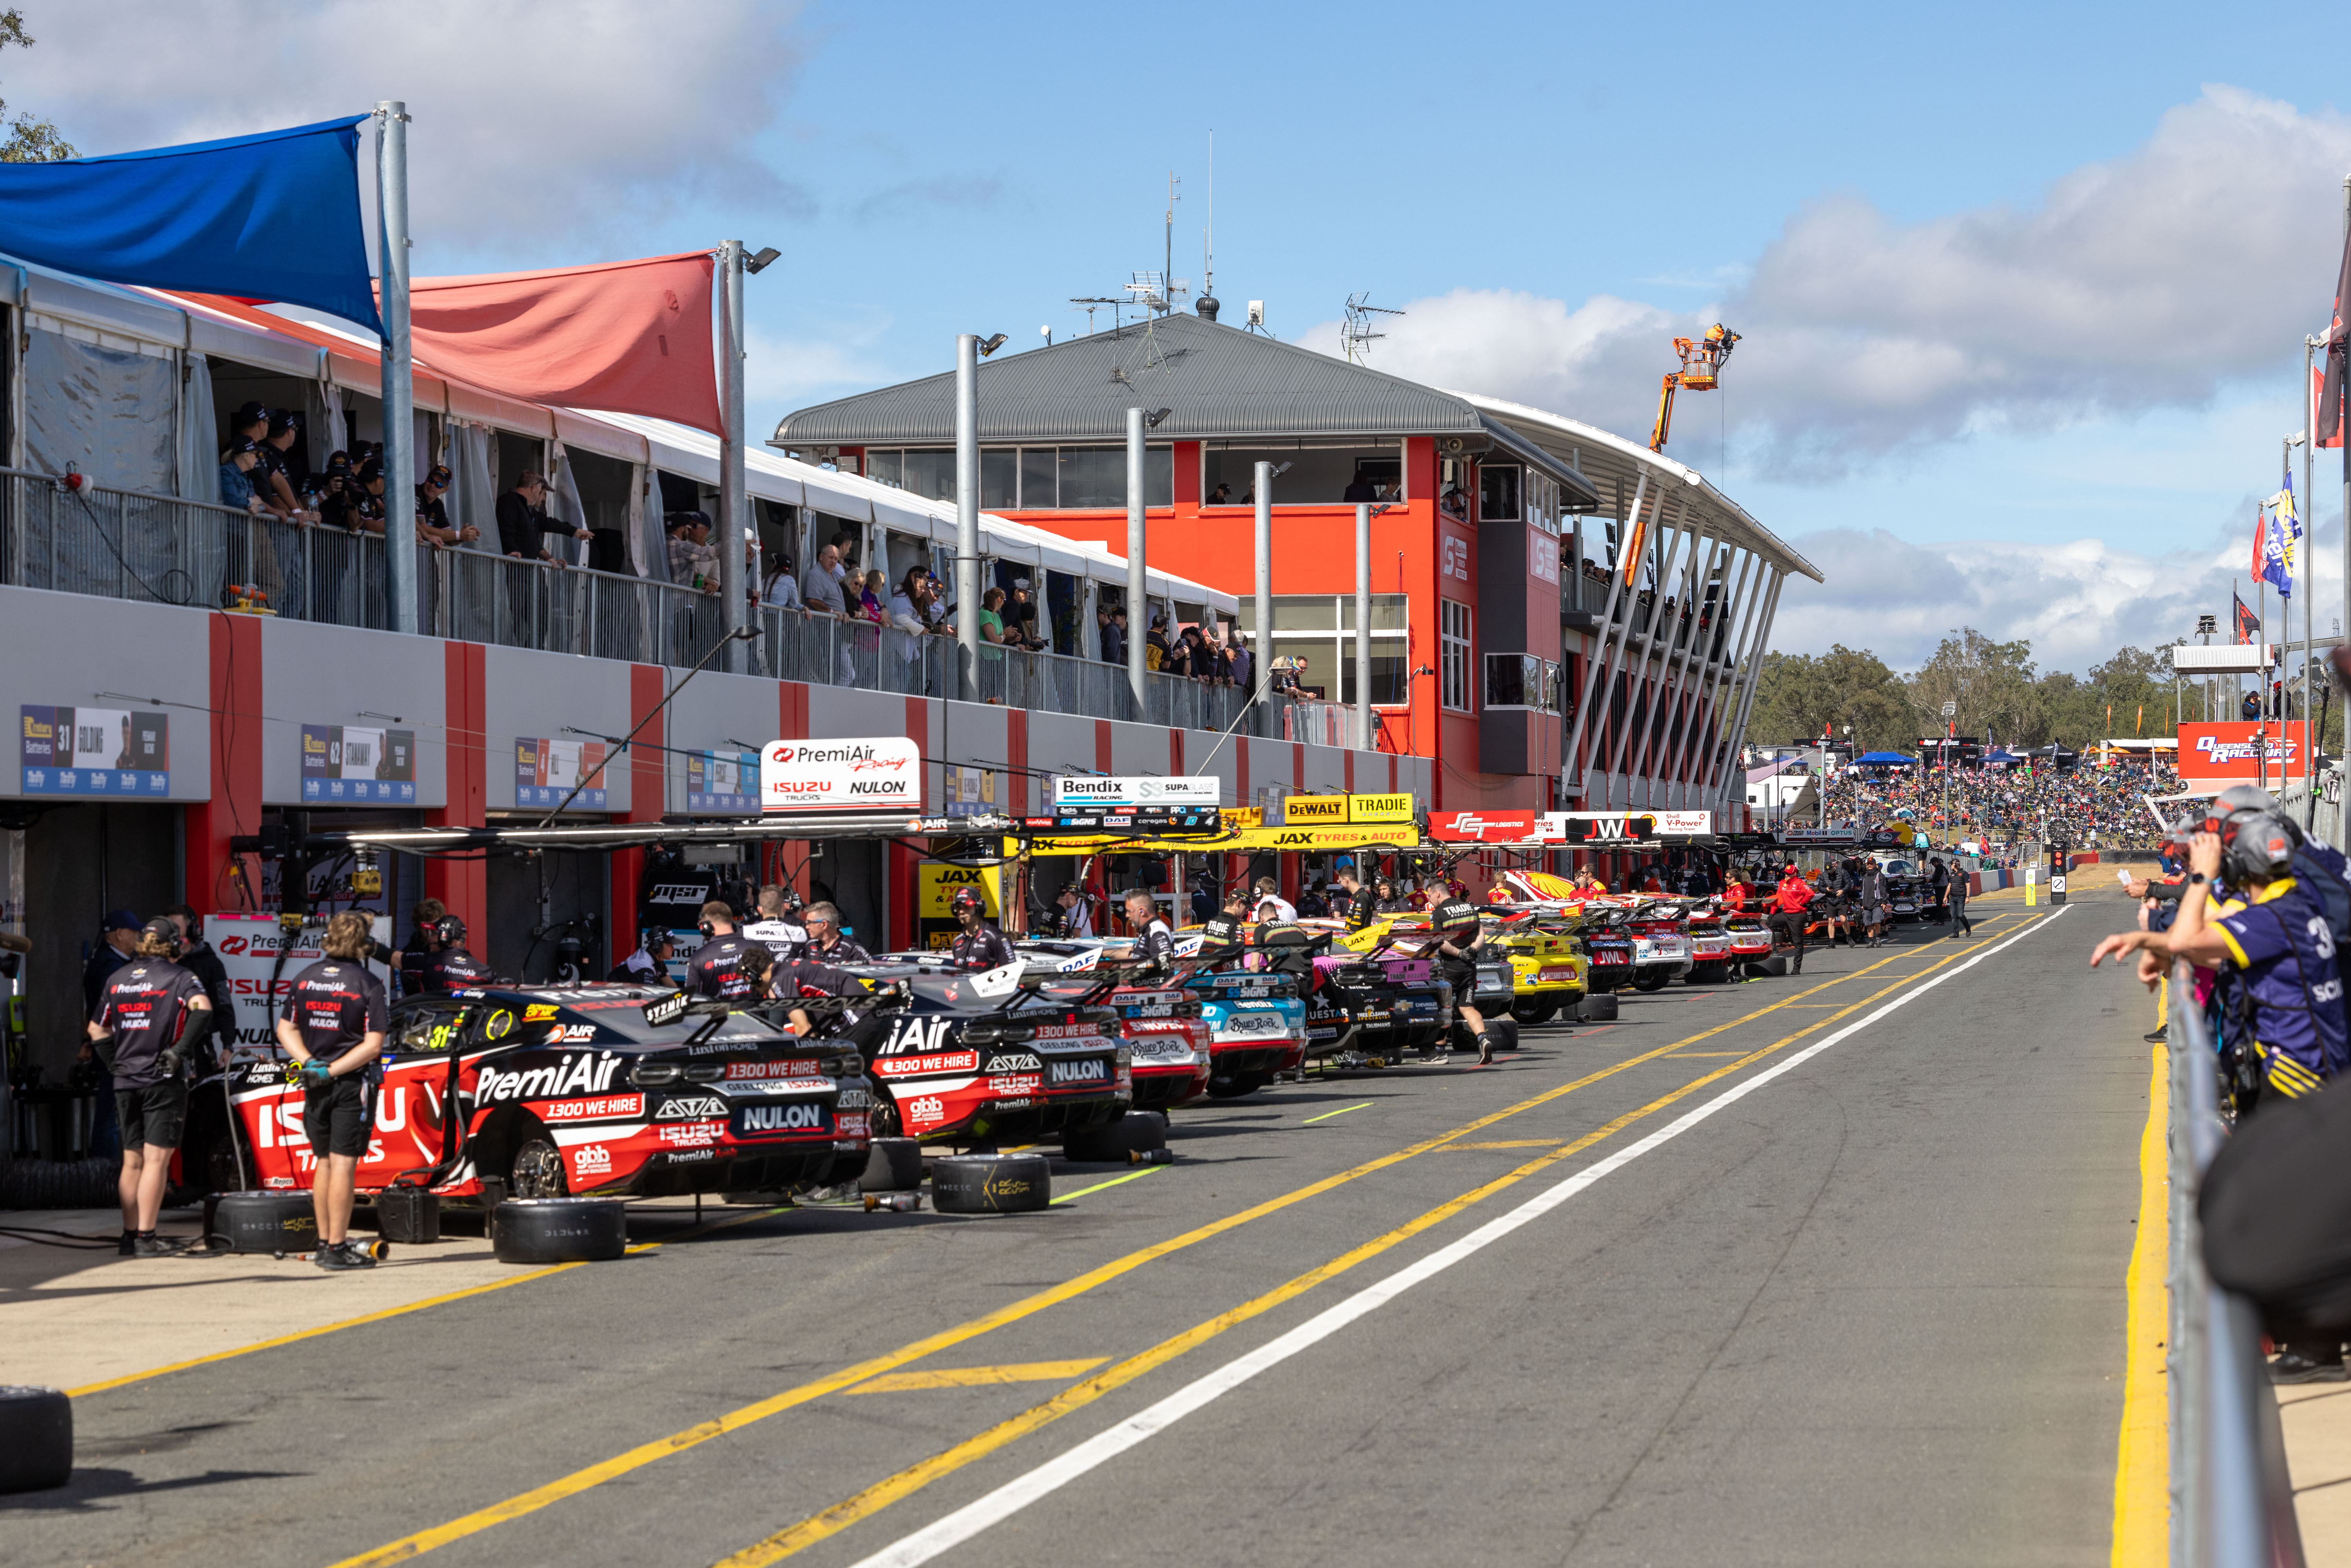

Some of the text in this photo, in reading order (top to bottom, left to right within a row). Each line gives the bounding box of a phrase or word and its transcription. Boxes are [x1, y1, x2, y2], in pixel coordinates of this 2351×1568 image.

[58, 725, 70, 751] 31
[78, 726, 103, 753] GOLDING
[2196, 736, 2274, 751] QUEENSLD
[25, 740, 51, 754] Batteries
[330, 741, 340, 764] 62
[798, 745, 875, 762] PremiAir
[306, 755, 324, 767] Batteries
[848, 757, 912, 772] Racing
[774, 781, 831, 792] ISUZU
[850, 781, 906, 793] NULON
[1063, 780, 1122, 793] Bendix
[1290, 803, 1341, 815] DEWALT
[1357, 798, 1406, 811] TRADIE
[923, 819, 948, 828] AIR
[1185, 816, 1198, 826] 10
[1205, 816, 1215, 825] 4
[1584, 819, 1638, 839] JWL
[1273, 833, 1314, 844] JAX
[1316, 833, 1358, 841] TYRES
[935, 870, 982, 883] JAX
[1443, 903, 1473, 915] TRADIE
[1349, 936, 1366, 946] JAX
[1174, 942, 1198, 956] DAF
[1062, 955, 1094, 972] DAF
[1599, 951, 1623, 964] JWL
[444, 965, 476, 978] PremiAir
[1546, 971, 1575, 980] PIZZAHUT.COM.AU
[117, 982, 153, 994] PremiAir
[306, 980, 346, 992] PremiAir
[118, 1002, 152, 1012] ISUZU
[306, 1001, 341, 1012] ISUZU
[647, 995, 688, 1021] SYZMIK
[1234, 1001, 1275, 1009] Bendix
[1007, 1009, 1038, 1019] Luxton
[121, 1019, 150, 1028] NULON
[309, 1018, 339, 1028] NULON
[1129, 1019, 1184, 1032] SINOPEC
[1230, 1018, 1280, 1032] Bruce Rock
[429, 1025, 451, 1048] 31
[565, 1025, 596, 1036] AIR
[1038, 1023, 1098, 1038] 1300 WE HIRE
[688, 1043, 758, 1056] Luxton HOMES
[1040, 1039, 1110, 1049] GEELONG ISUZU
[1132, 1040, 1184, 1059] Bruce Rock
[730, 1060, 817, 1077] 1300 WE HIRE
[923, 1055, 972, 1070] WE HIRE
[1052, 1060, 1104, 1081] NULON
[247, 1074, 274, 1083] HOMES
[475, 1050, 622, 1108] PremiAir
[726, 1078, 829, 1092] GEELONG ISUZU
[989, 1076, 1039, 1090] ISUZU
[547, 1098, 638, 1117] 1300 WE HIRE
[910, 1097, 943, 1117] gbb
[995, 1098, 1031, 1110] PremiAir
[744, 1104, 819, 1130] NULON
[659, 1124, 724, 1141] ISUZU
[672, 1138, 713, 1147] TRUCKS
[575, 1145, 610, 1169] gbb
[668, 1150, 714, 1163] PremiAir
[273, 1178, 293, 1187] Repco
